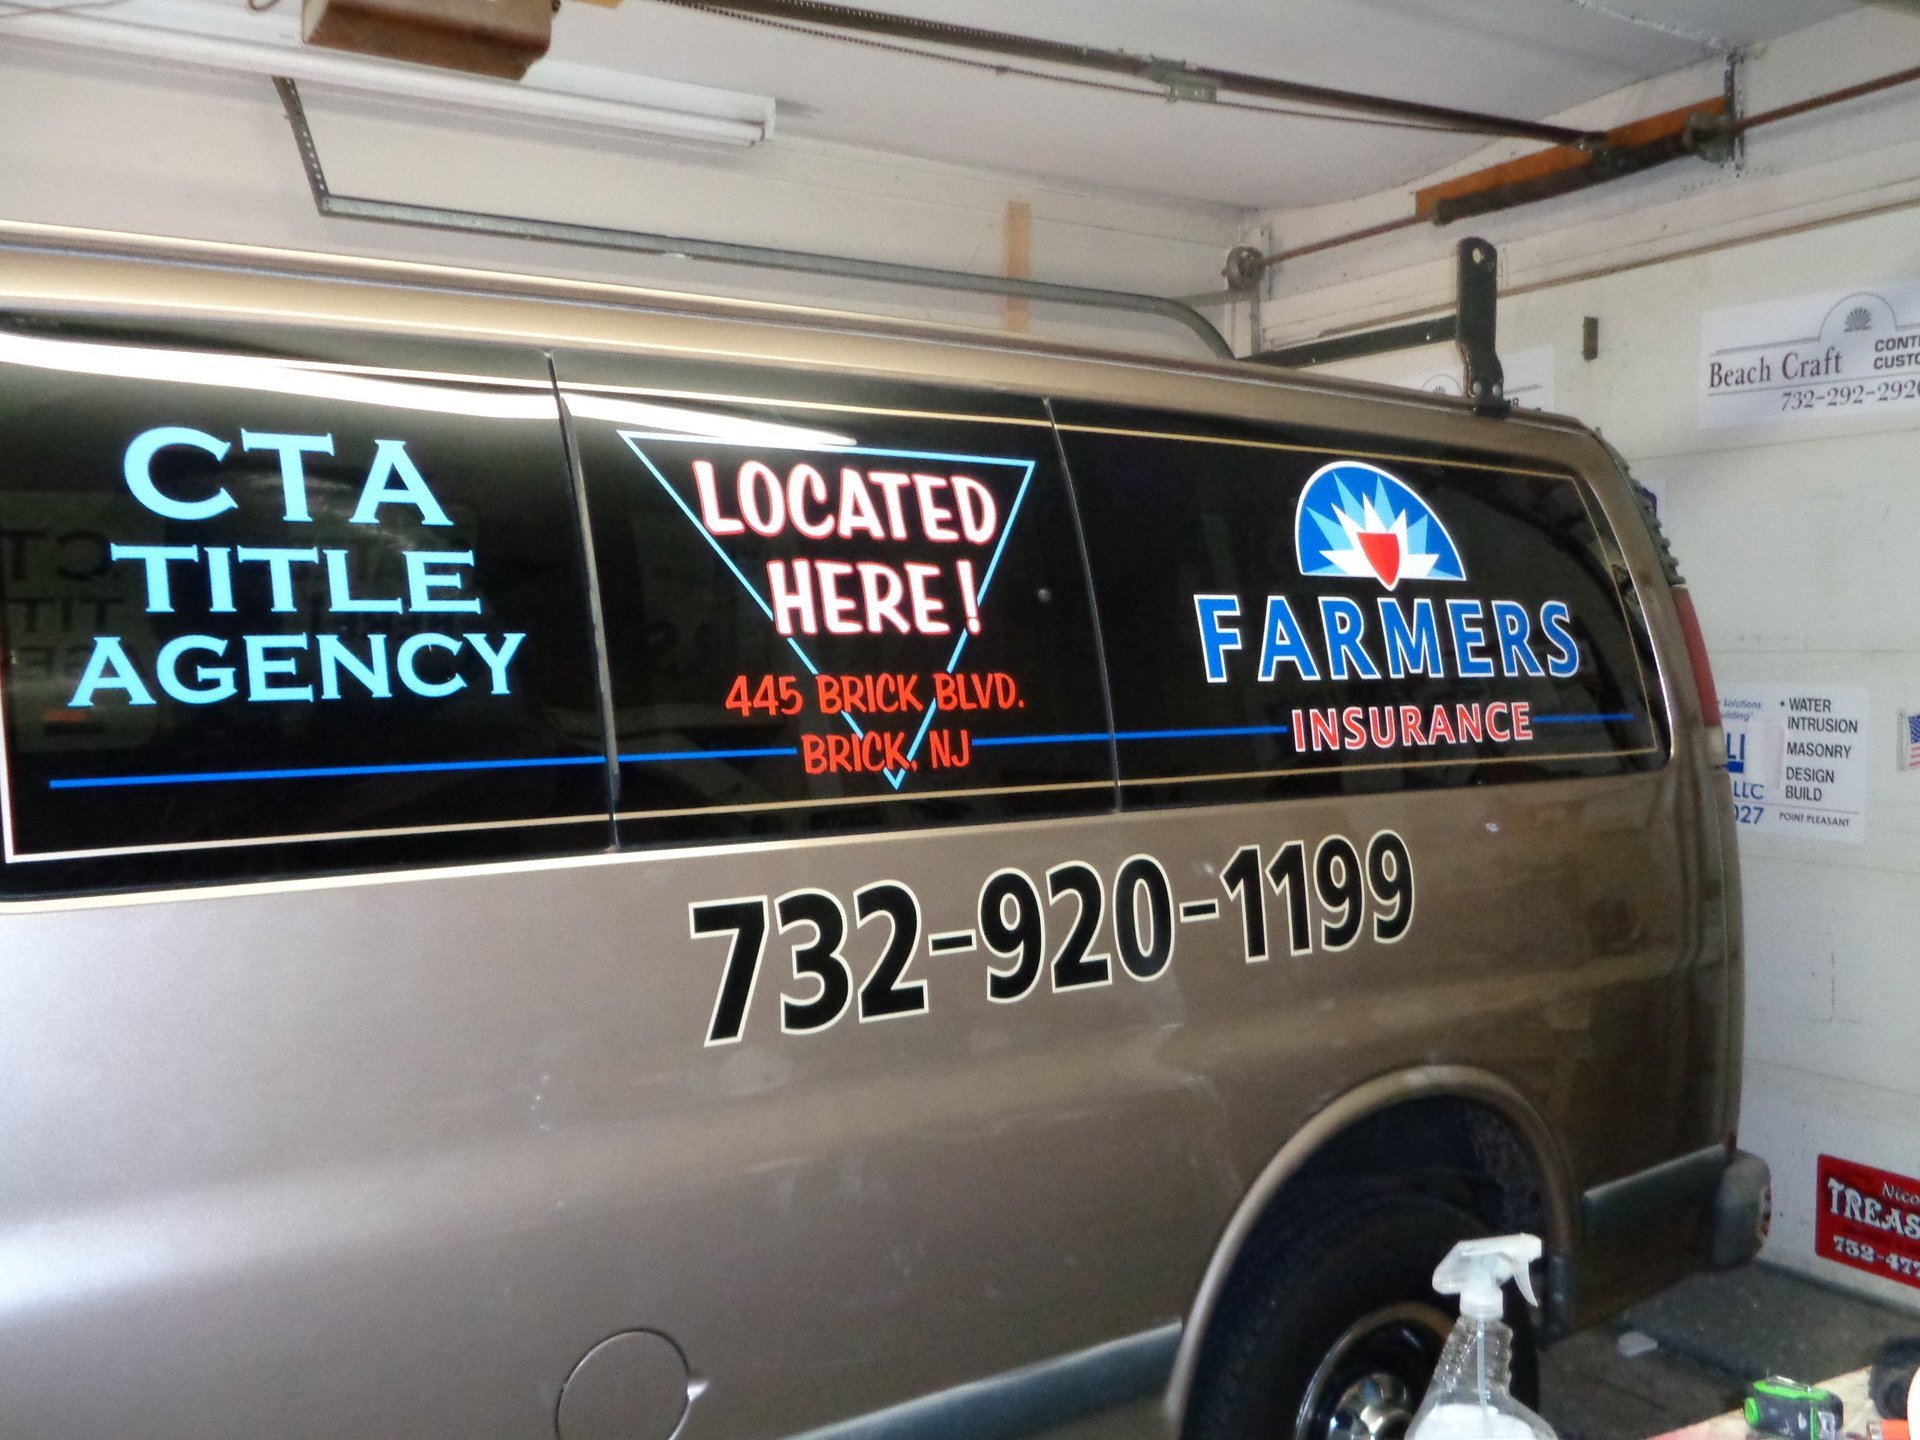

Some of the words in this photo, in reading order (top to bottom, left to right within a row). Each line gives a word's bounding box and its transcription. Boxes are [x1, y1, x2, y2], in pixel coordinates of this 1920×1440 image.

[1874, 334, 1920, 353] CONT
[1709, 356, 1771, 388] Beach
[1781, 346, 1843, 380] Craft
[1781, 380, 1920, 411] 732-292-292
[123, 425, 454, 526] CTA
[692, 460, 998, 544] LOCATED
[109, 543, 482, 614] TITLE
[1193, 594, 1580, 684] FARMERS
[67, 632, 526, 707] AGENCY
[724, 674, 803, 717] 445
[817, 673, 923, 714] BRICK
[933, 672, 1026, 711] BLVD.
[1722, 700, 1762, 709] Solutions
[1789, 698, 1831, 712] WATER
[1292, 701, 1533, 752] INSURANCE
[1787, 717, 1858, 733] INTRUSION
[801, 730, 919, 774] BRICK,
[929, 729, 971, 769] NJ
[1786, 741, 1852, 759] MASONRY
[1733, 781, 1764, 800] LLC
[1785, 785, 1822, 801] BUILD
[1786, 767, 1834, 784] DESIGN
[1779, 812, 1804, 822] POINT
[1807, 815, 1850, 827] PLEASANT
[688, 829, 1415, 1048] 732-920-1199
